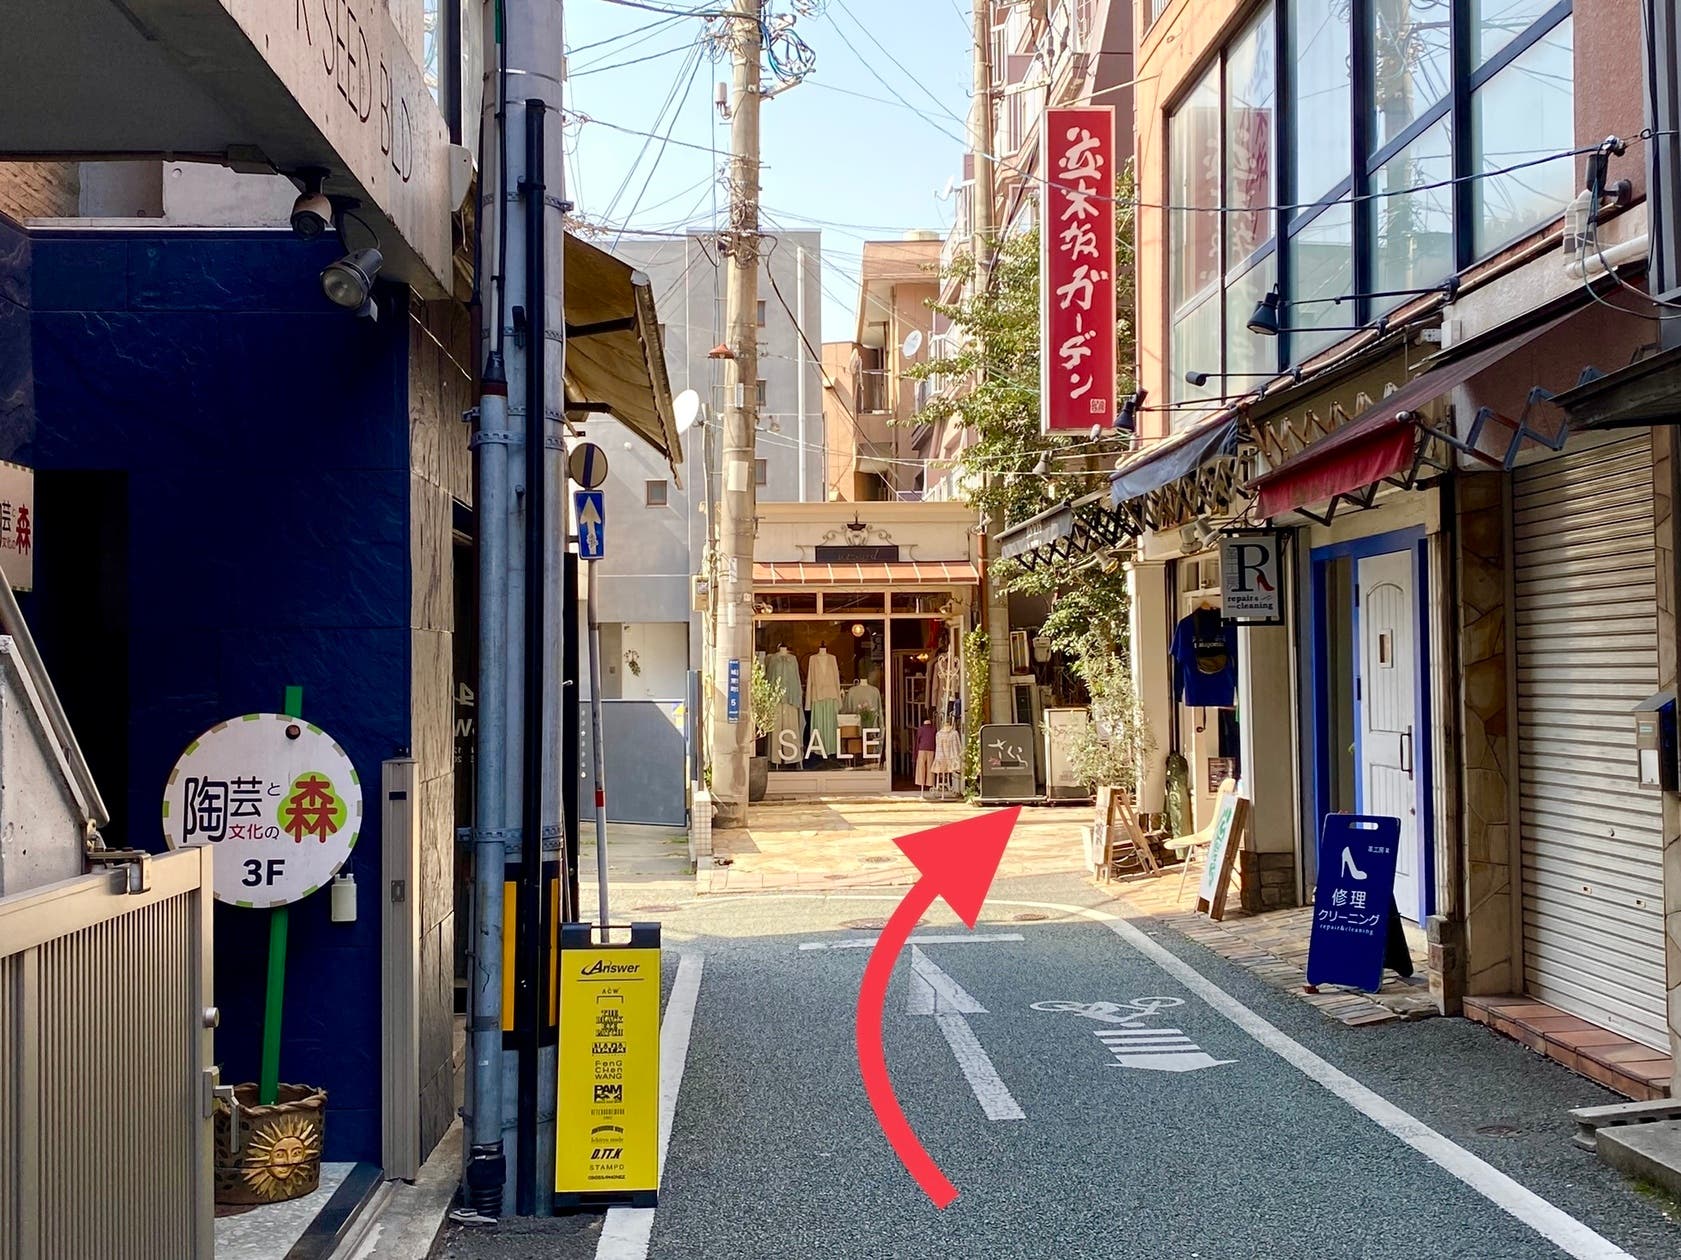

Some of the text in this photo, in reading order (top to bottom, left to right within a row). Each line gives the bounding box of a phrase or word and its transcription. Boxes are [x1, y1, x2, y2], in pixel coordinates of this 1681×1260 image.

[380, 60, 412, 182] BLD
[1056, 126, 1109, 400] 並木坂ガーデン
[16, 504, 31, 555] 森
[1229, 543, 1275, 592] R
[1236, 602, 1273, 610] cleaning
[777, 727, 881, 761] SALE
[284, 775, 338, 844] 森
[228, 823, 280, 840] 文化の
[241, 859, 286, 887] 3F
[1331, 888, 1366, 909] 修理
[1318, 909, 1379, 925] クリーニング
[581, 959, 640, 975] Answer
[594, 1084, 622, 1094] PAM
